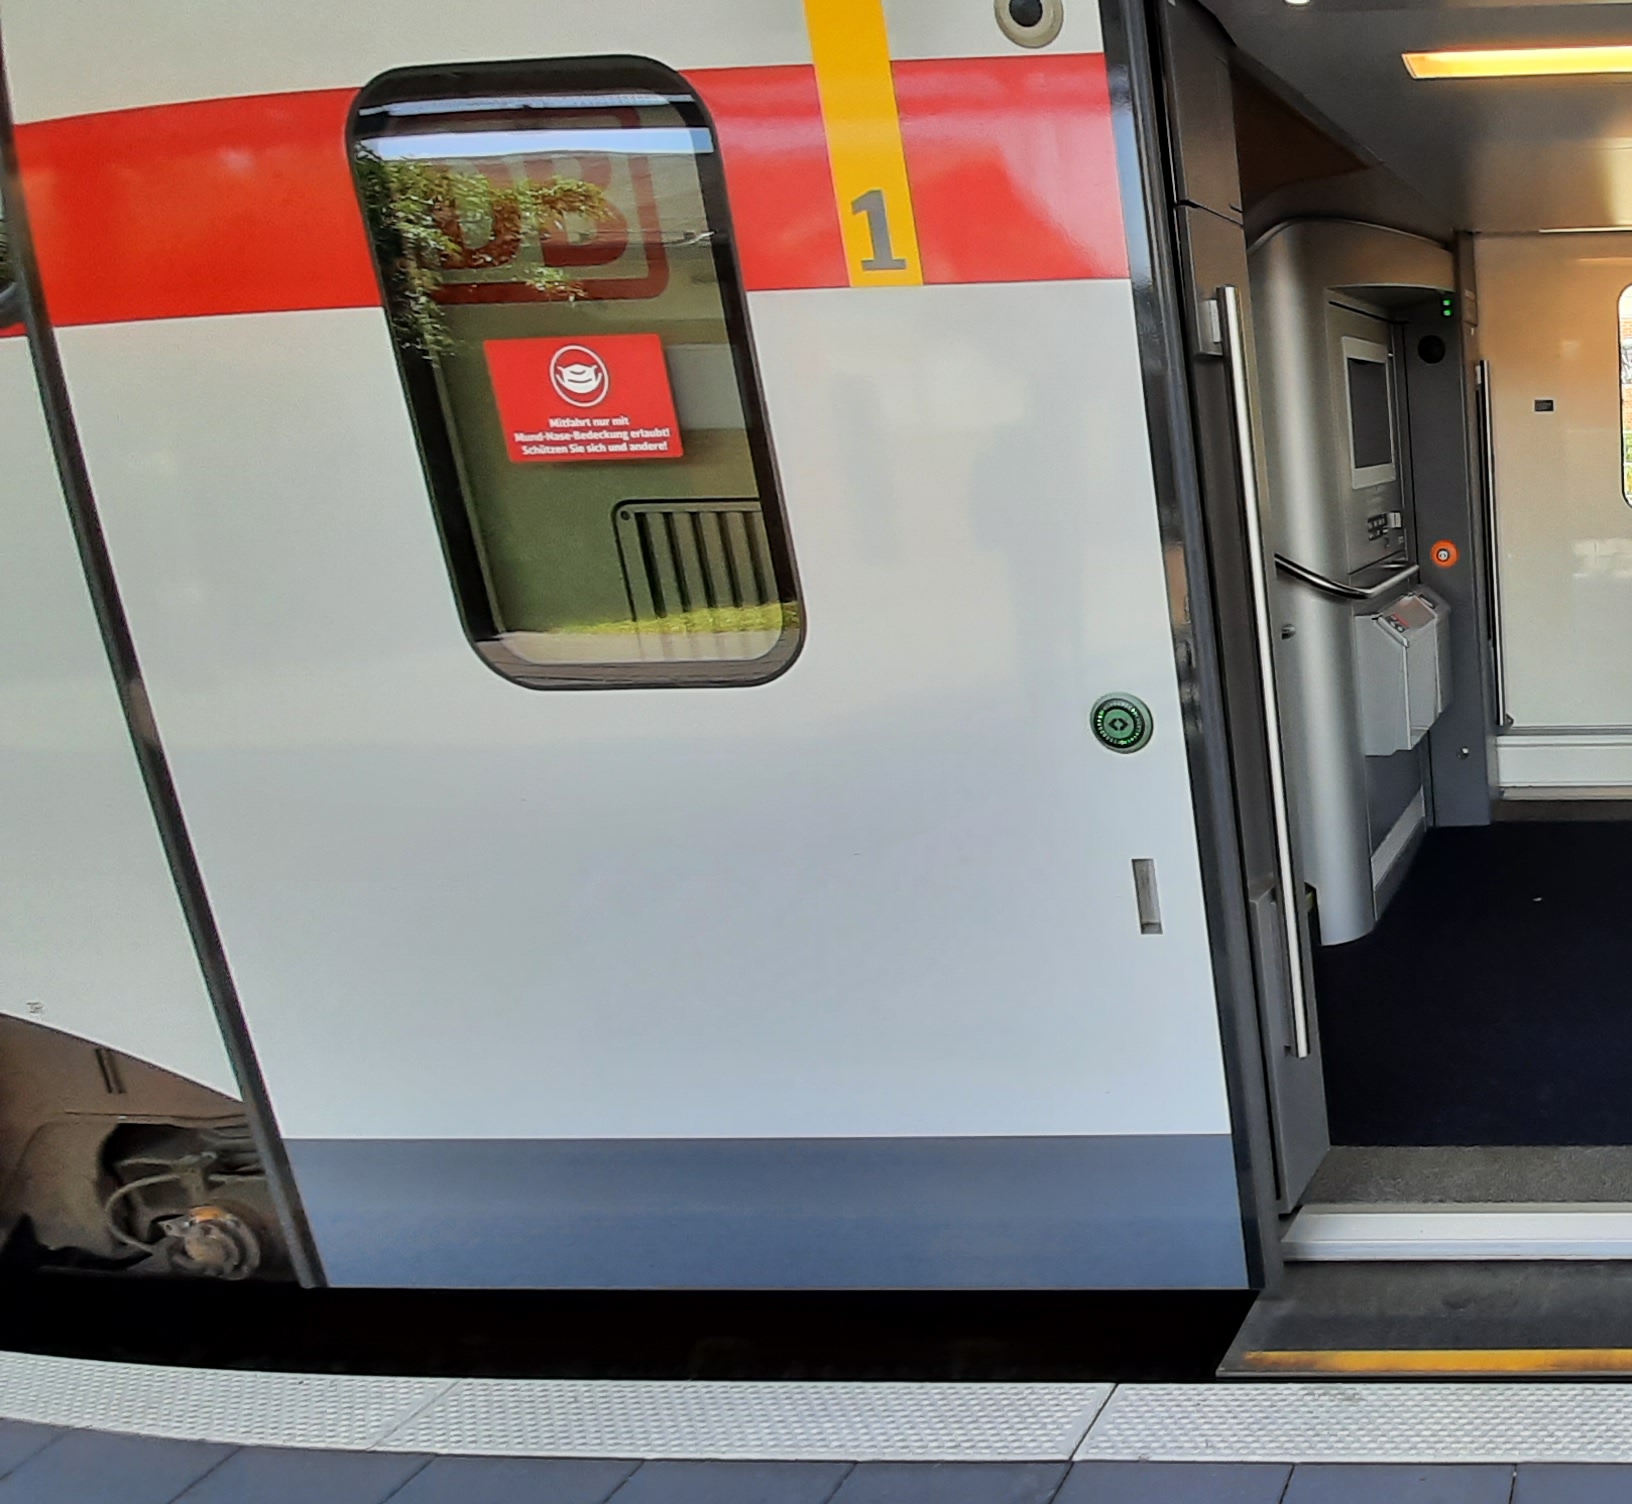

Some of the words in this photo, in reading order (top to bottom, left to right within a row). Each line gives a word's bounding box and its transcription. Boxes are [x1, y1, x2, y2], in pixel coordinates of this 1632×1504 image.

[419, 142, 629, 268] DB
[851, 189, 907, 271] 1
[548, 417, 592, 428] Mitfahrt
[592, 417, 610, 427] nur
[611, 415, 630, 426] mit
[514, 429, 629, 441] Mund-Nase-Bedeckung
[629, 427, 670, 439] erlaubt!
[521, 443, 568, 455] Schützen
[568, 442, 586, 453] Sie
[586, 442, 607, 453] sich
[607, 441, 628, 452] und
[629, 440, 669, 452] andere!
